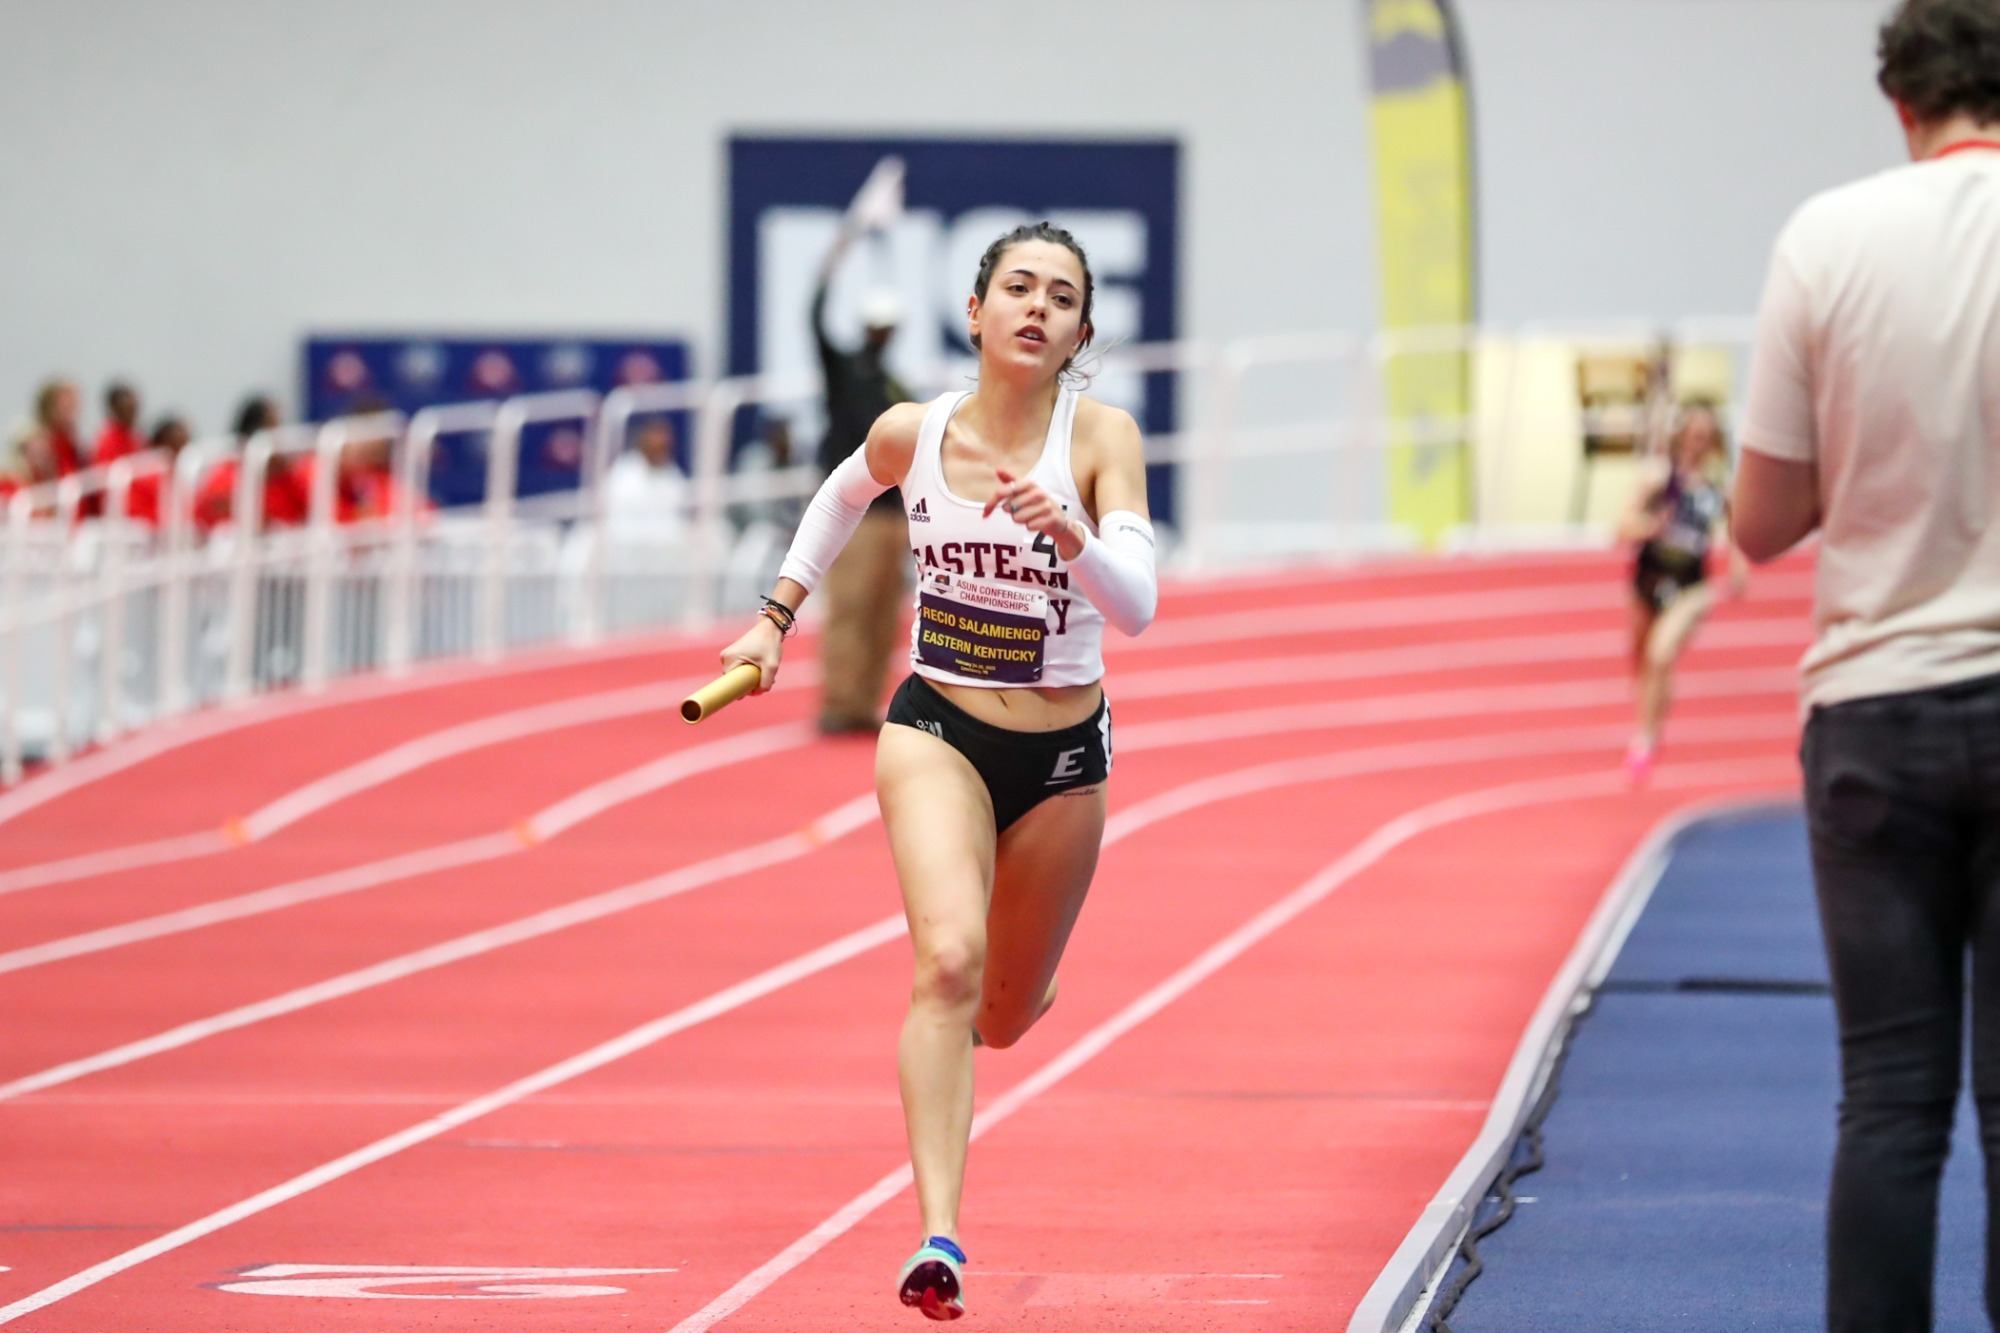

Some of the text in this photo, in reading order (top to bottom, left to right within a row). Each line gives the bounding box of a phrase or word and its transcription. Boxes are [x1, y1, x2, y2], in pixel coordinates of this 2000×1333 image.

[912, 542, 1069, 591] ASTE
[957, 580, 1036, 602] ASUN CONFERENCE
[960, 591, 1030, 612] CHAMPIONSHIPS
[923, 606, 956, 627] RECIO
[959, 617, 1041, 641] SALAMIENGO
[923, 630, 1036, 662] EASTERN KENTUCKY
[1051, 746, 1086, 778] E
